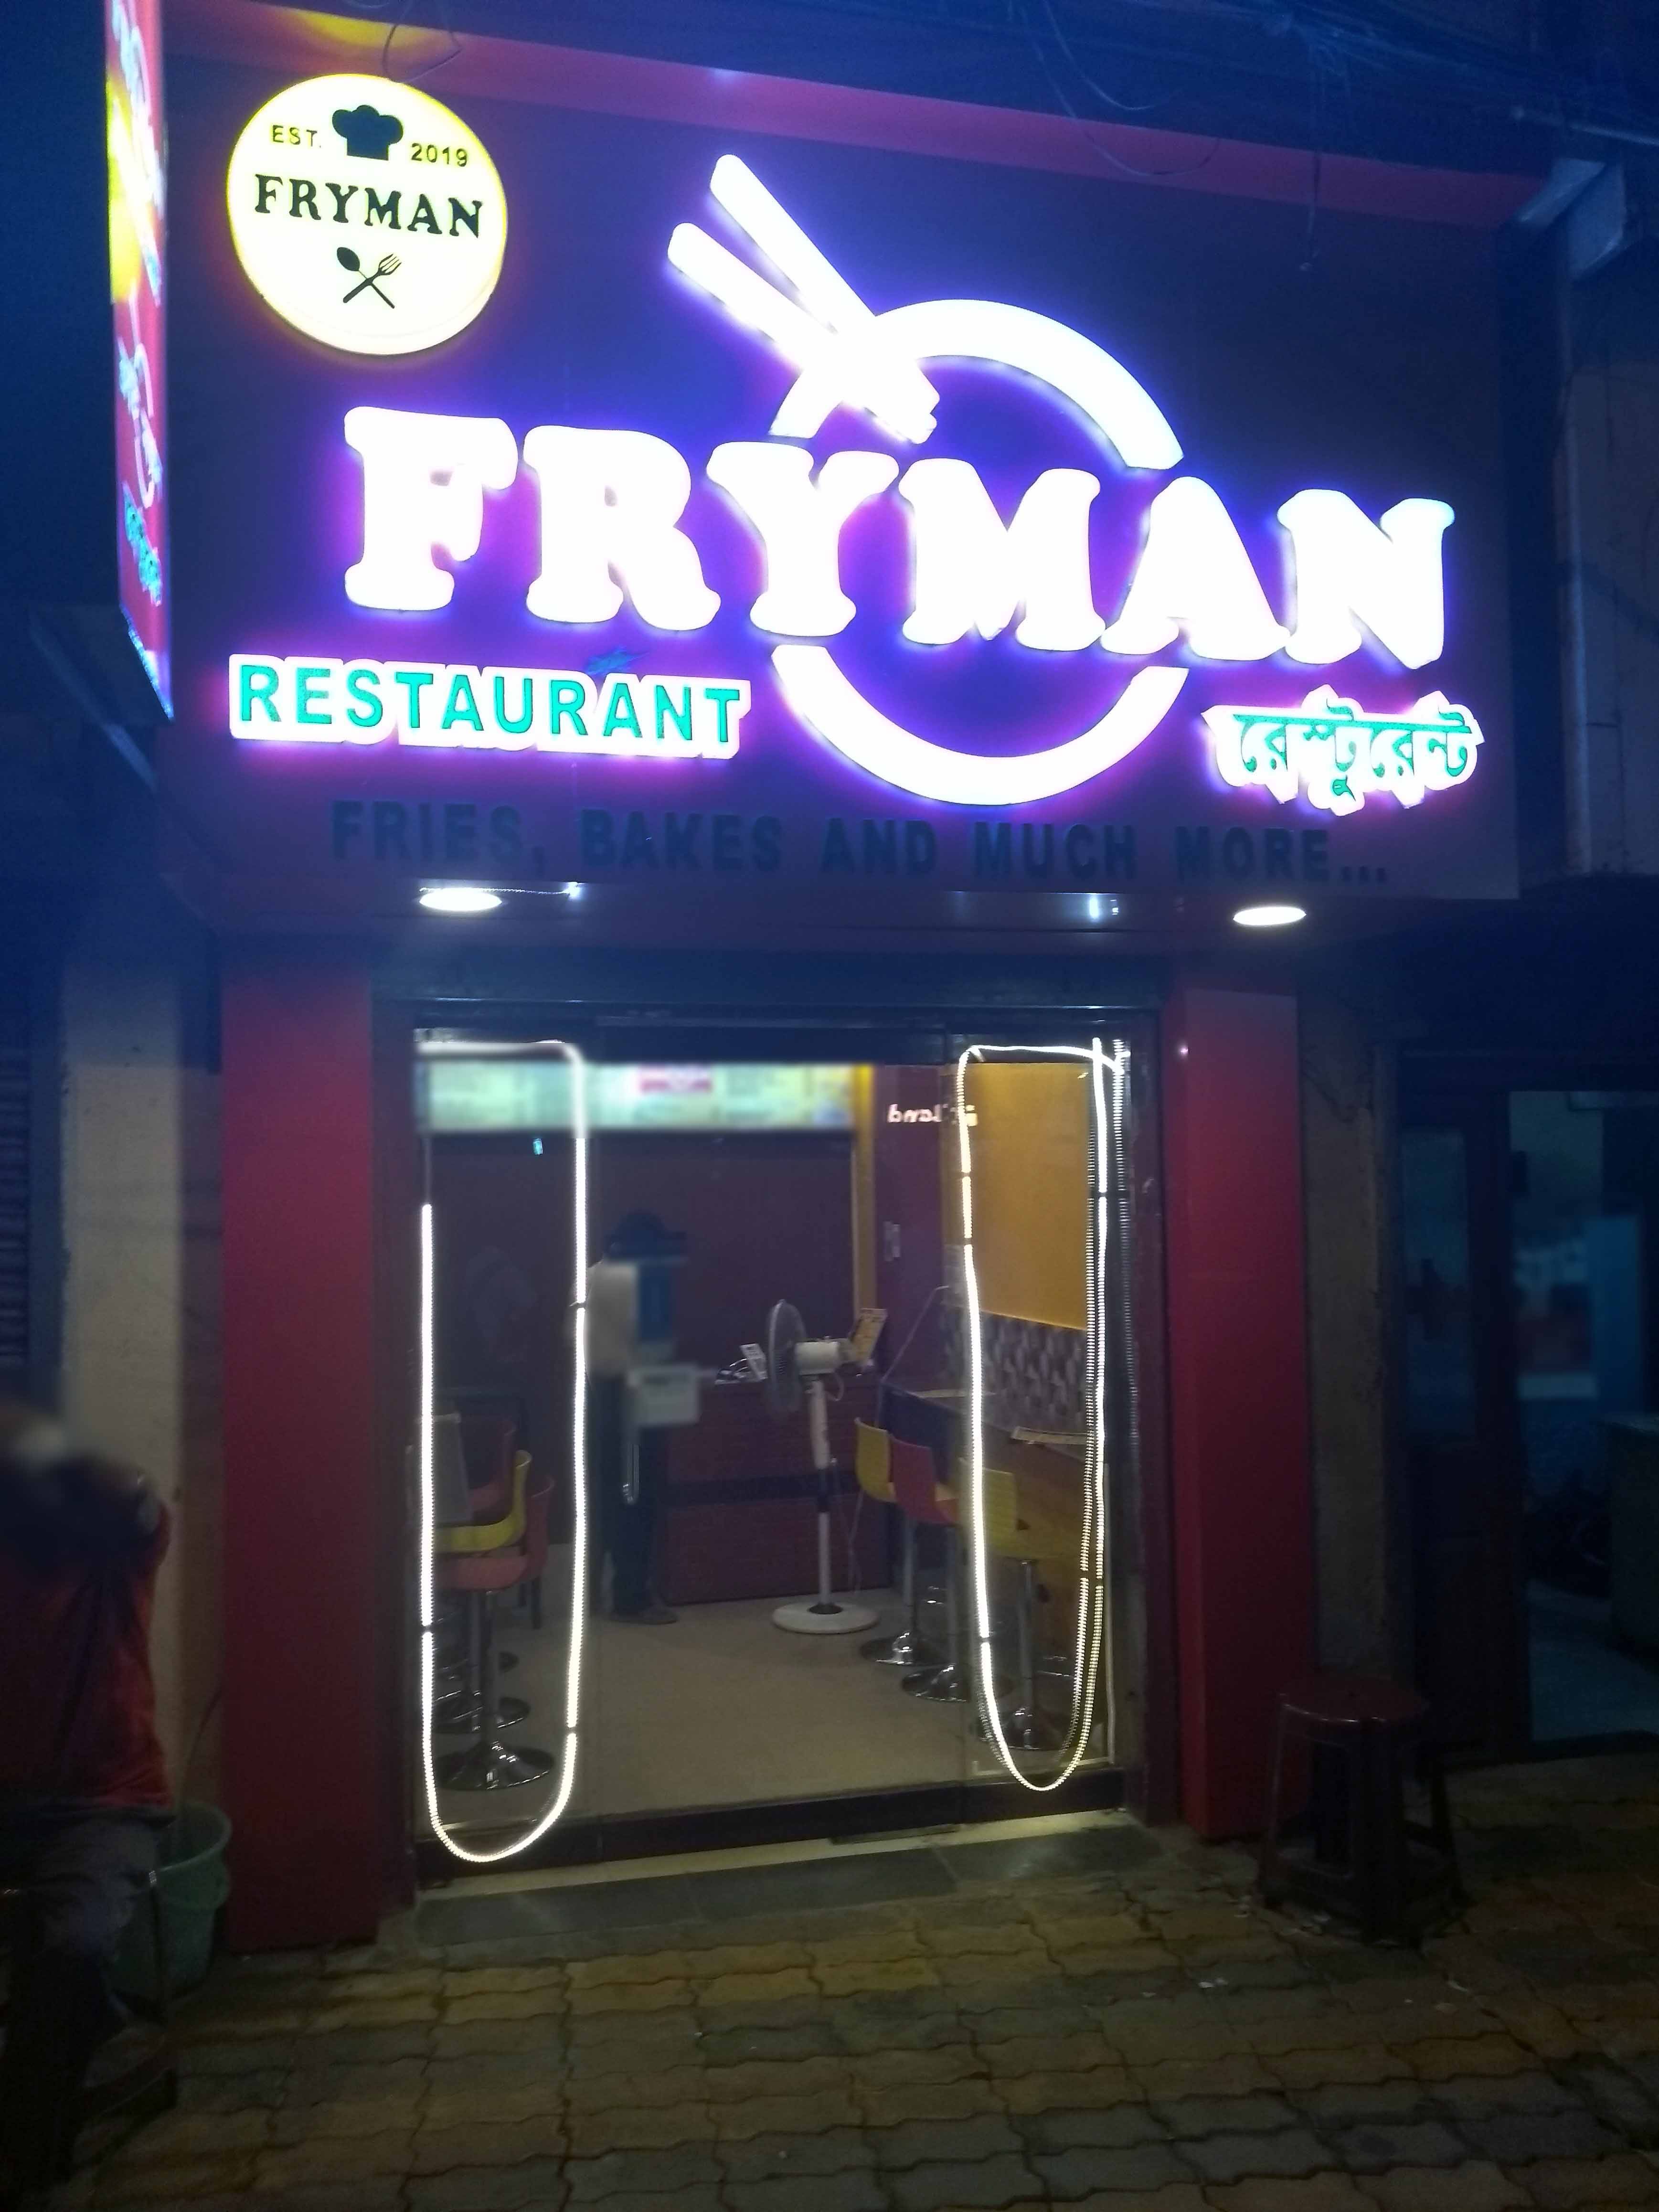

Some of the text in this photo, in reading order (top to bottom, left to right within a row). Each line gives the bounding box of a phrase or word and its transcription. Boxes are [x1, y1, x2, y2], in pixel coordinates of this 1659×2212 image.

[272, 124, 468, 167] EST. 2019
[254, 173, 483, 238] FRYMAN
[344, 405, 1456, 670] FRYMAN
[239, 664, 741, 743] RESTAURANT
[1233, 698, 1473, 801] রেস্টুরেন্ট
[329, 799, 1390, 885] FRIES, BAKES AND MUCH MORE...
